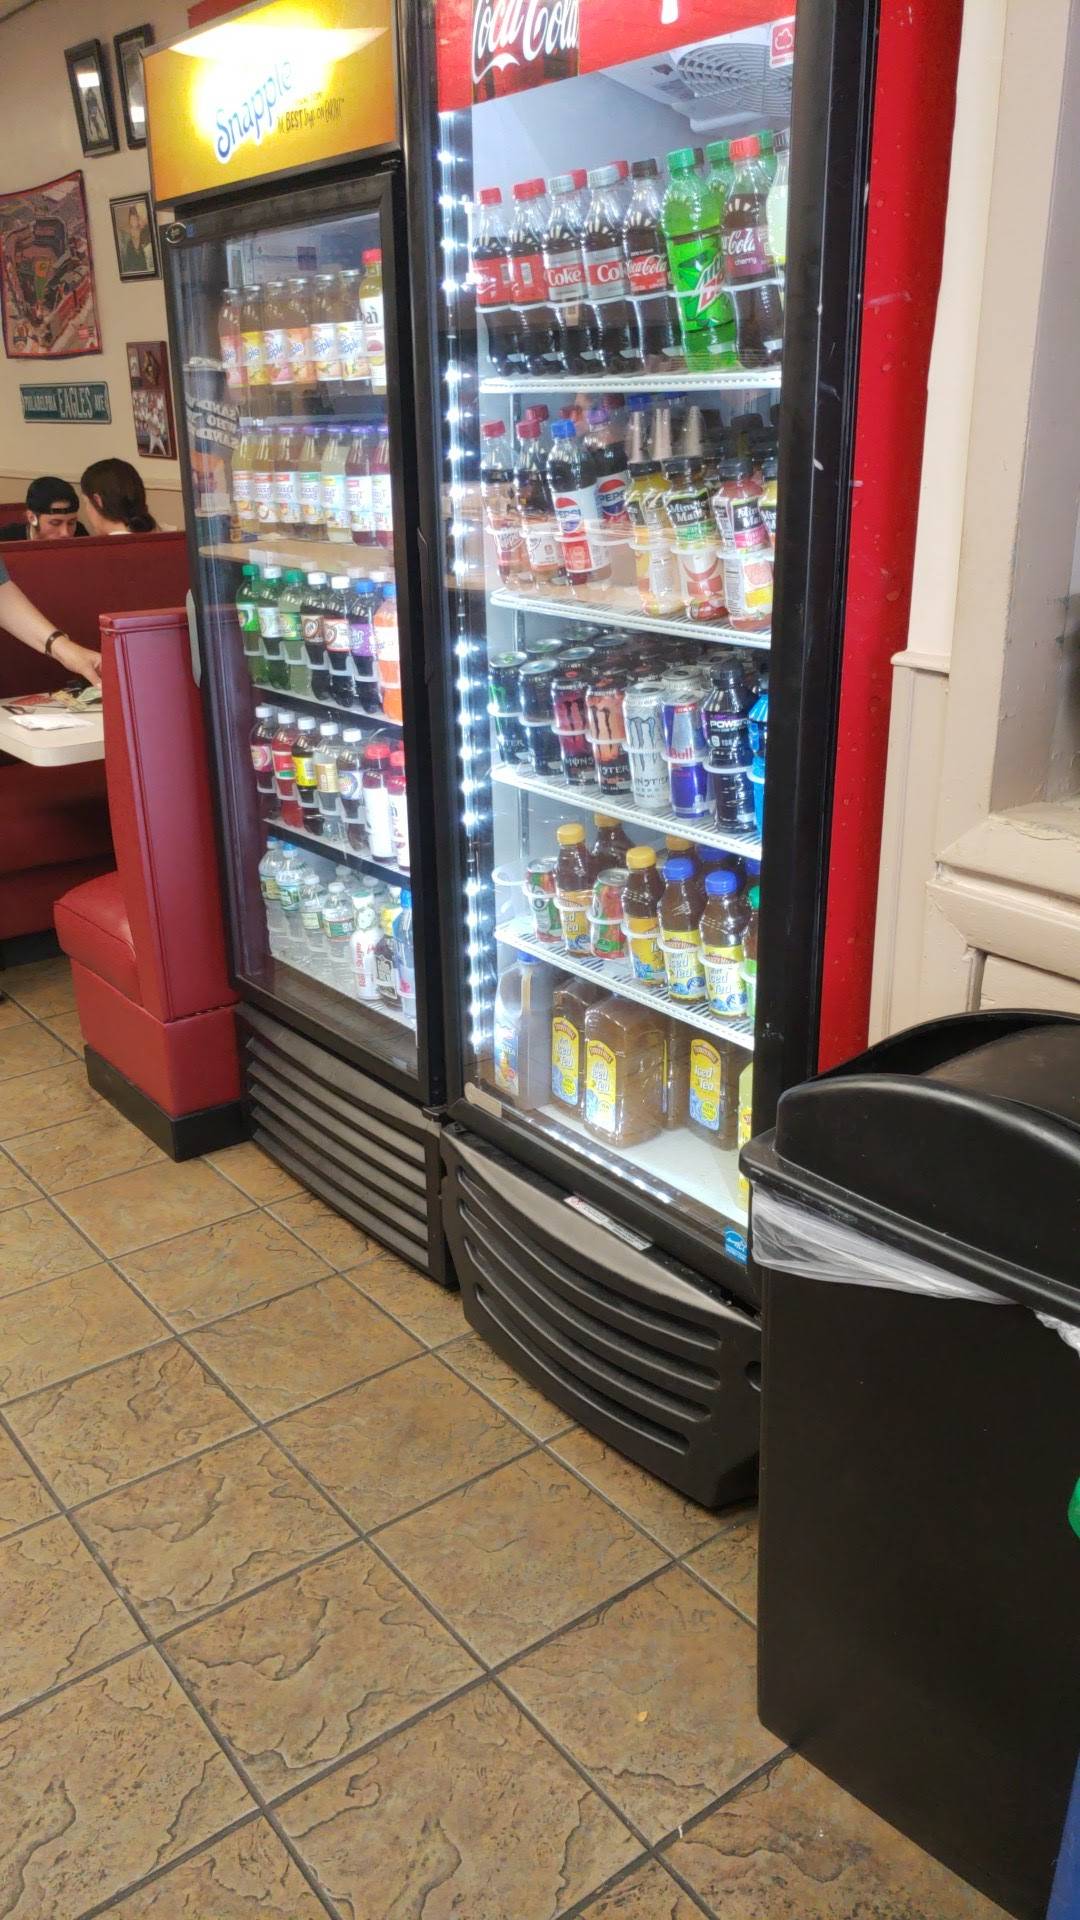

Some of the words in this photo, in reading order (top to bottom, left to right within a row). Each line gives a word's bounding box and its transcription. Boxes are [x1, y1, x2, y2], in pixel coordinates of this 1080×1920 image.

[216, 61, 292, 158] Snapple
[285, 108, 303, 131] BEST
[735, 256, 757, 266] cherry
[547, 267, 582, 287] Coke
[57, 386, 93, 419] EAGLES
[668, 499, 706, 514] Minute
[676, 508, 704, 523] Maid
[670, 746, 693, 760] Bull
[564, 757, 594, 767] MONS
[692, 1063, 713, 1080] Iced
[700, 1079, 715, 1092] Tea
